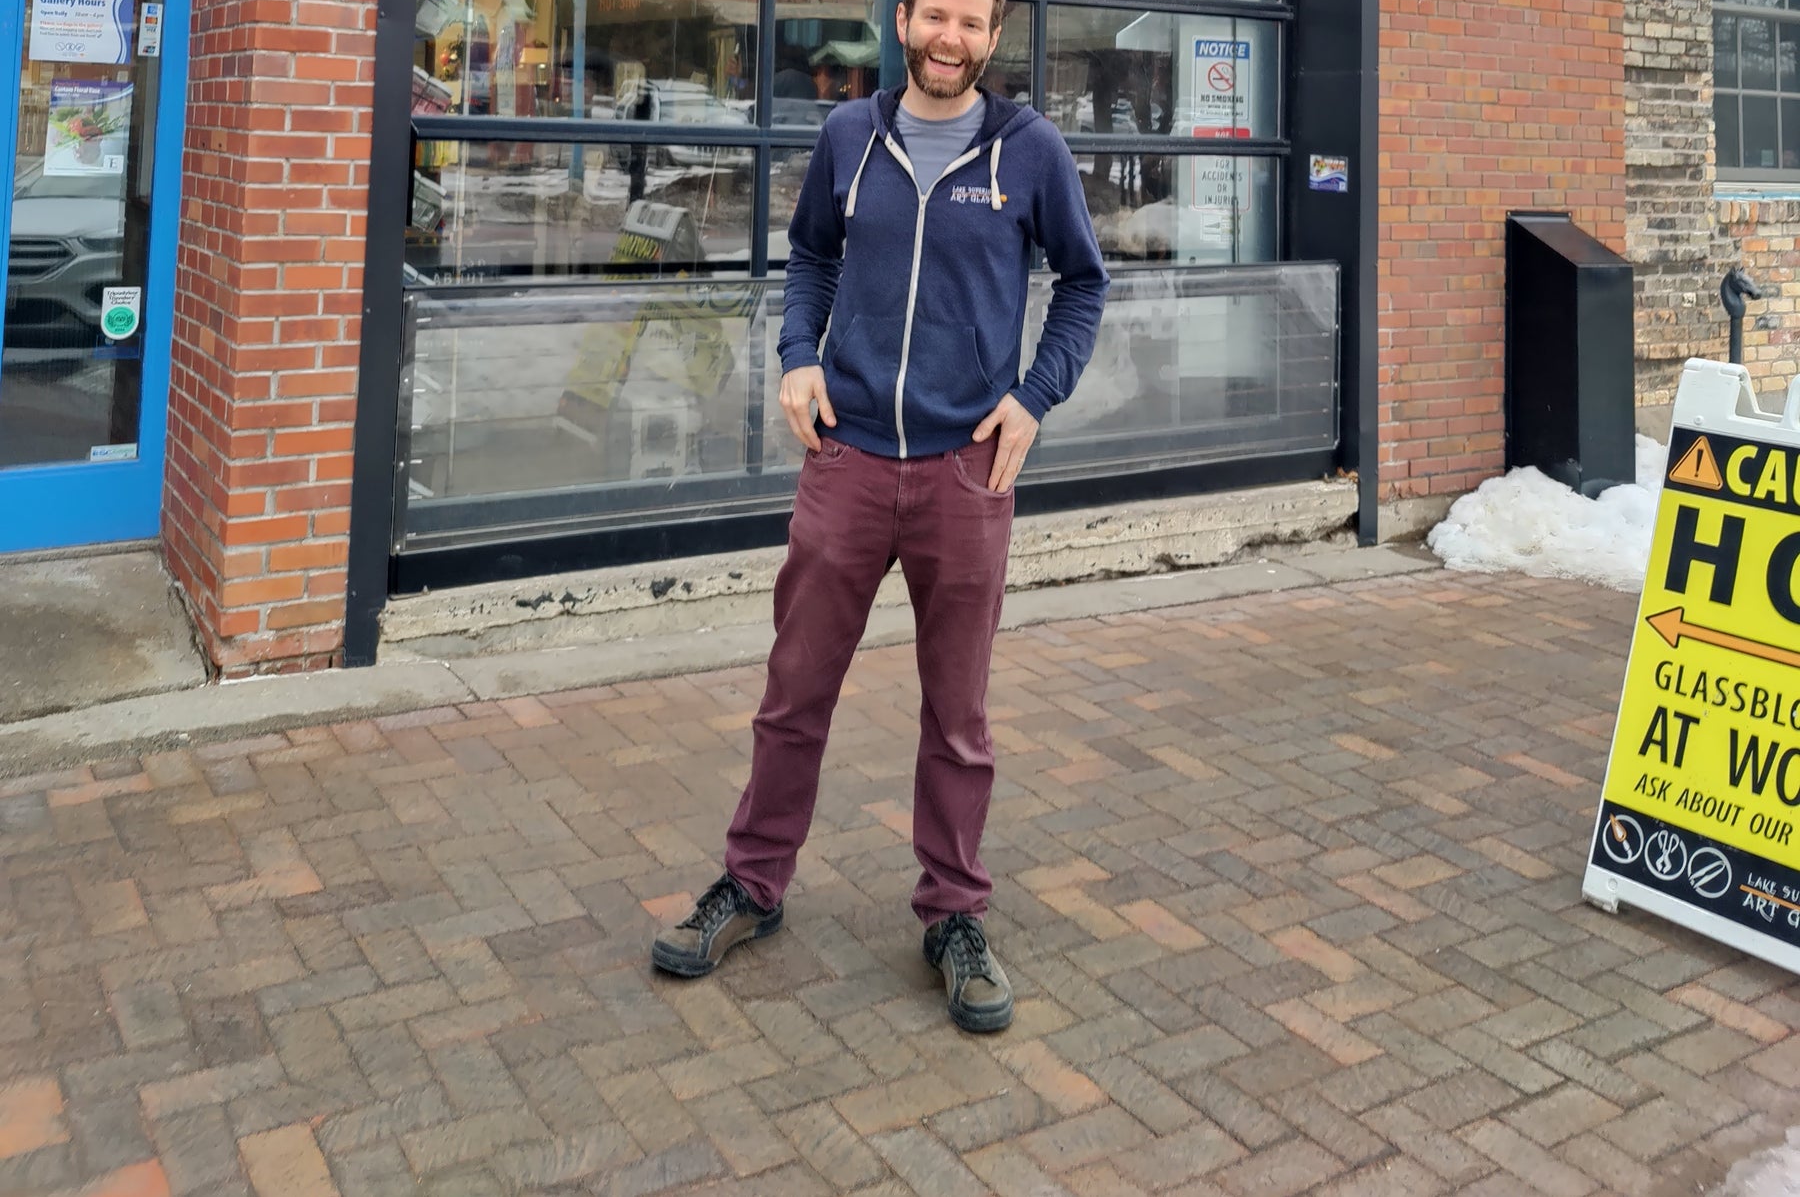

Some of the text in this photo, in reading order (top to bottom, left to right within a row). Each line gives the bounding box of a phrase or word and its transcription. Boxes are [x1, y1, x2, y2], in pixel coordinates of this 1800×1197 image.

[1199, 42, 1246, 57] NOTICE
[1201, 94, 1210, 102] NO
[1215, 159, 1230, 169] FOR
[1216, 184, 1228, 192] OR
[950, 192, 966, 205] ART
[1204, 195, 1238, 205] INJURI
[1725, 444, 1800, 507] CA
[1638, 705, 1700, 769] AT
[1633, 773, 1793, 846] ASK ABOUT OUR
[1747, 872, 1777, 897] LAKE
[1742, 892, 1780, 923] ART
